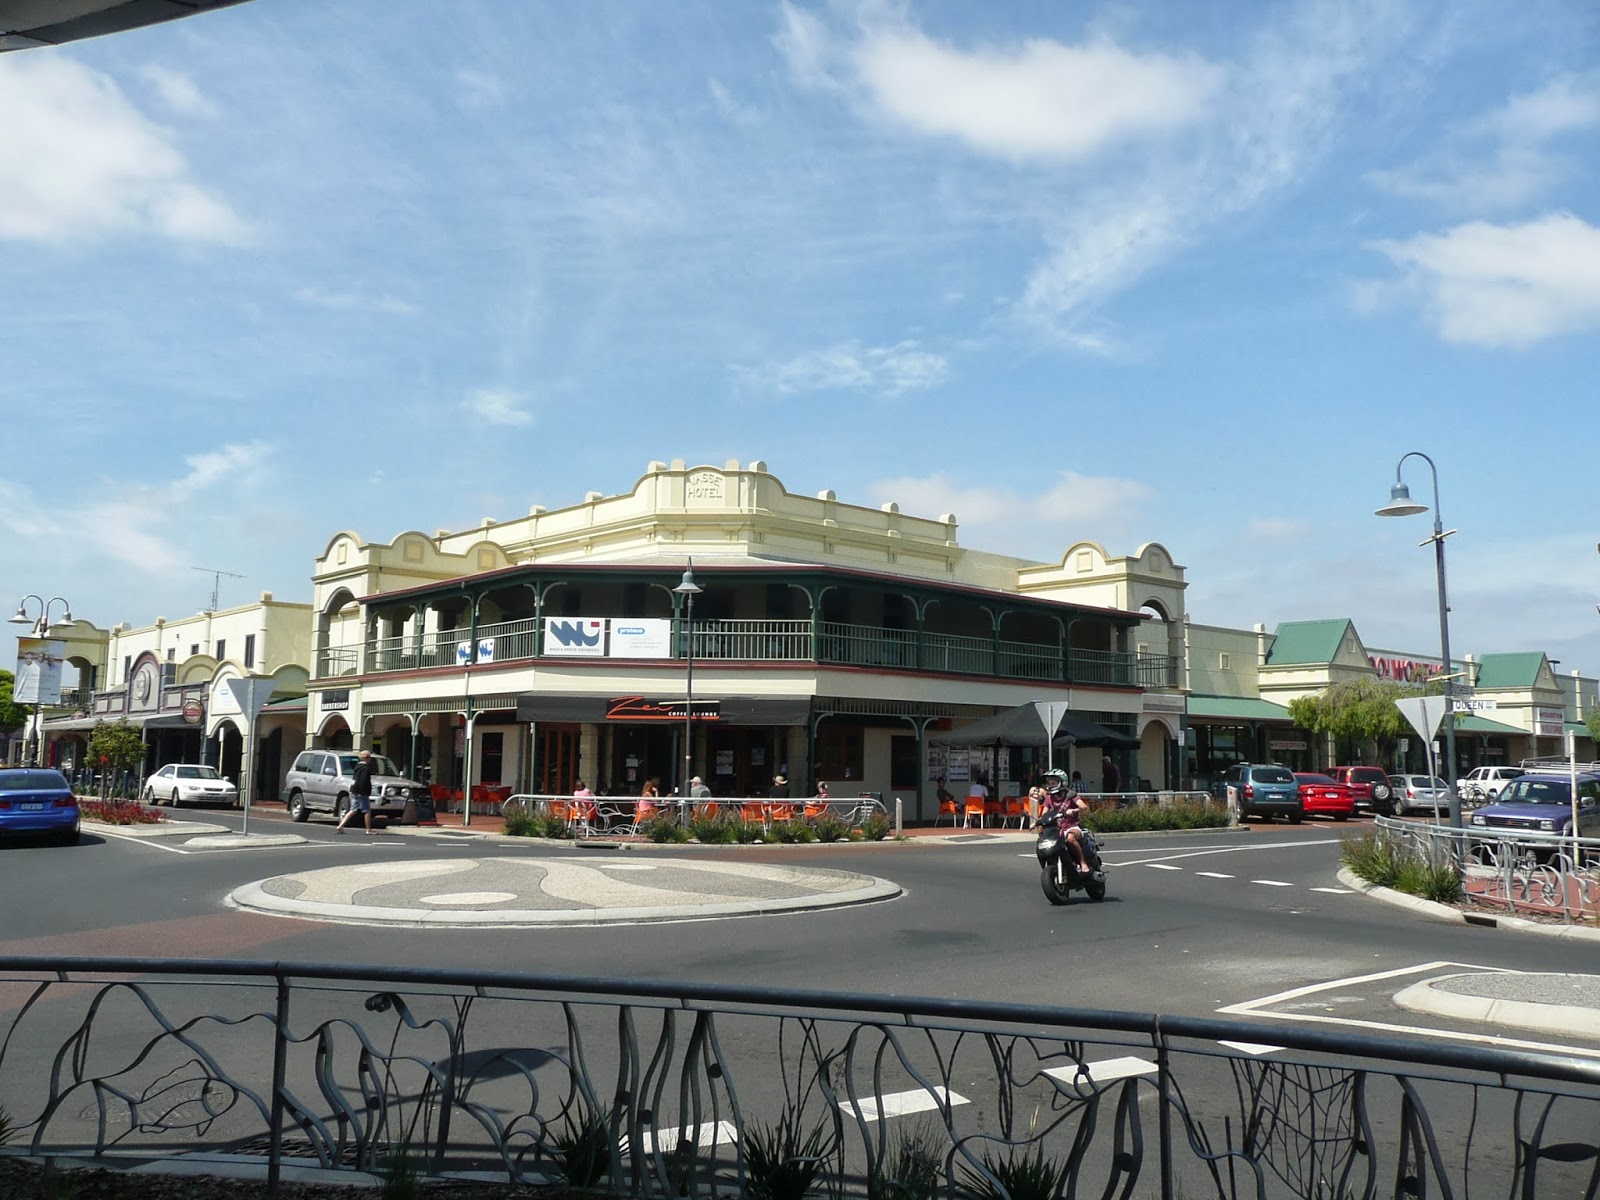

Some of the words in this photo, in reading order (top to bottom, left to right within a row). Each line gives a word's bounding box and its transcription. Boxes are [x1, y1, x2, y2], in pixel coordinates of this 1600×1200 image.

[688, 488, 723, 498] HOTEL
[321, 702, 349, 710] BARBERSHOP
[607, 696, 674, 716] Zen
[1455, 701, 1484, 710] QUEEN
